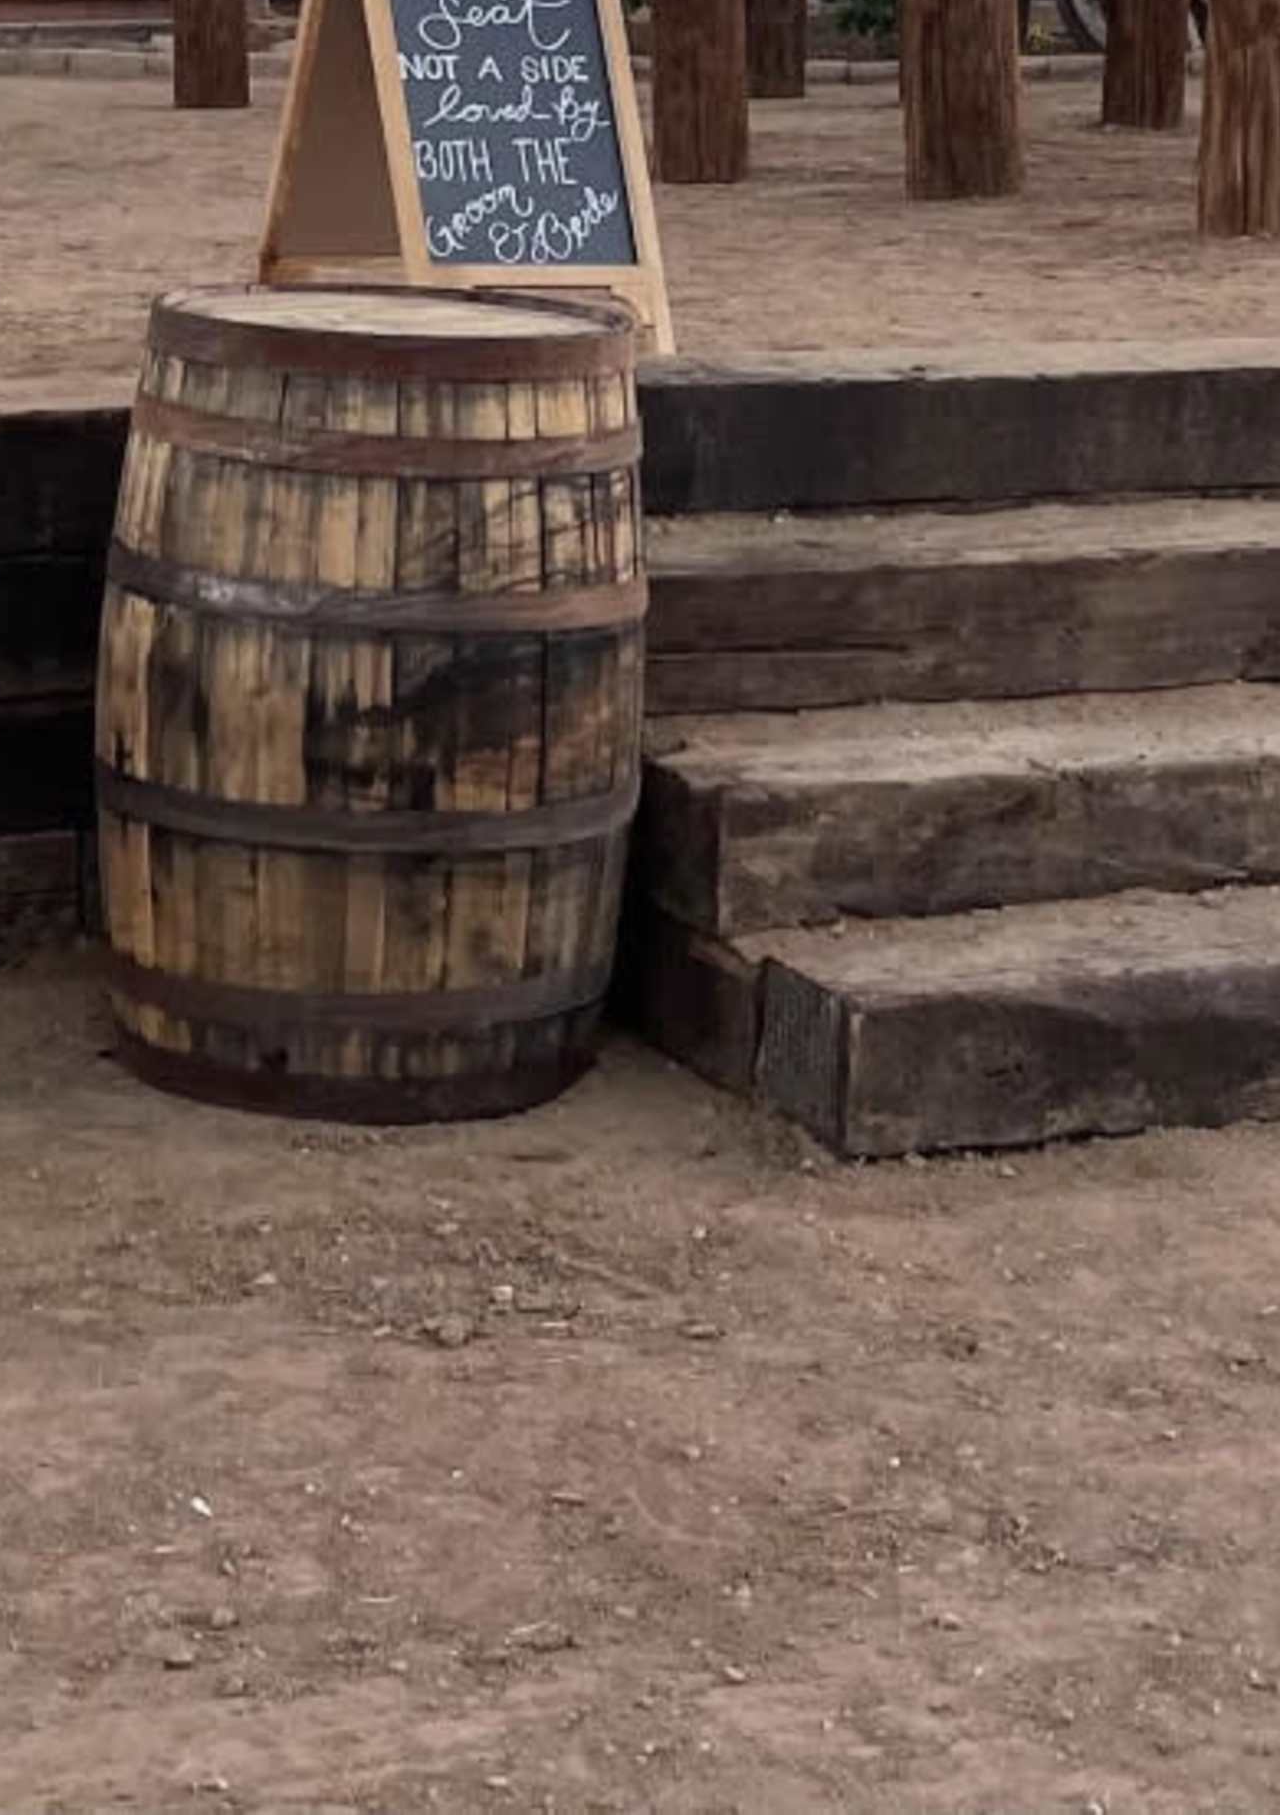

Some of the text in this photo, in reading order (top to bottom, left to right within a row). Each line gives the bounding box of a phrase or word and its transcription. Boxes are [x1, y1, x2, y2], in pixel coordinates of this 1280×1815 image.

[399, 54, 589, 83] NOT A SIDE
[415, 137, 577, 185] BOTH THE
[488, 222, 530, 263] &
